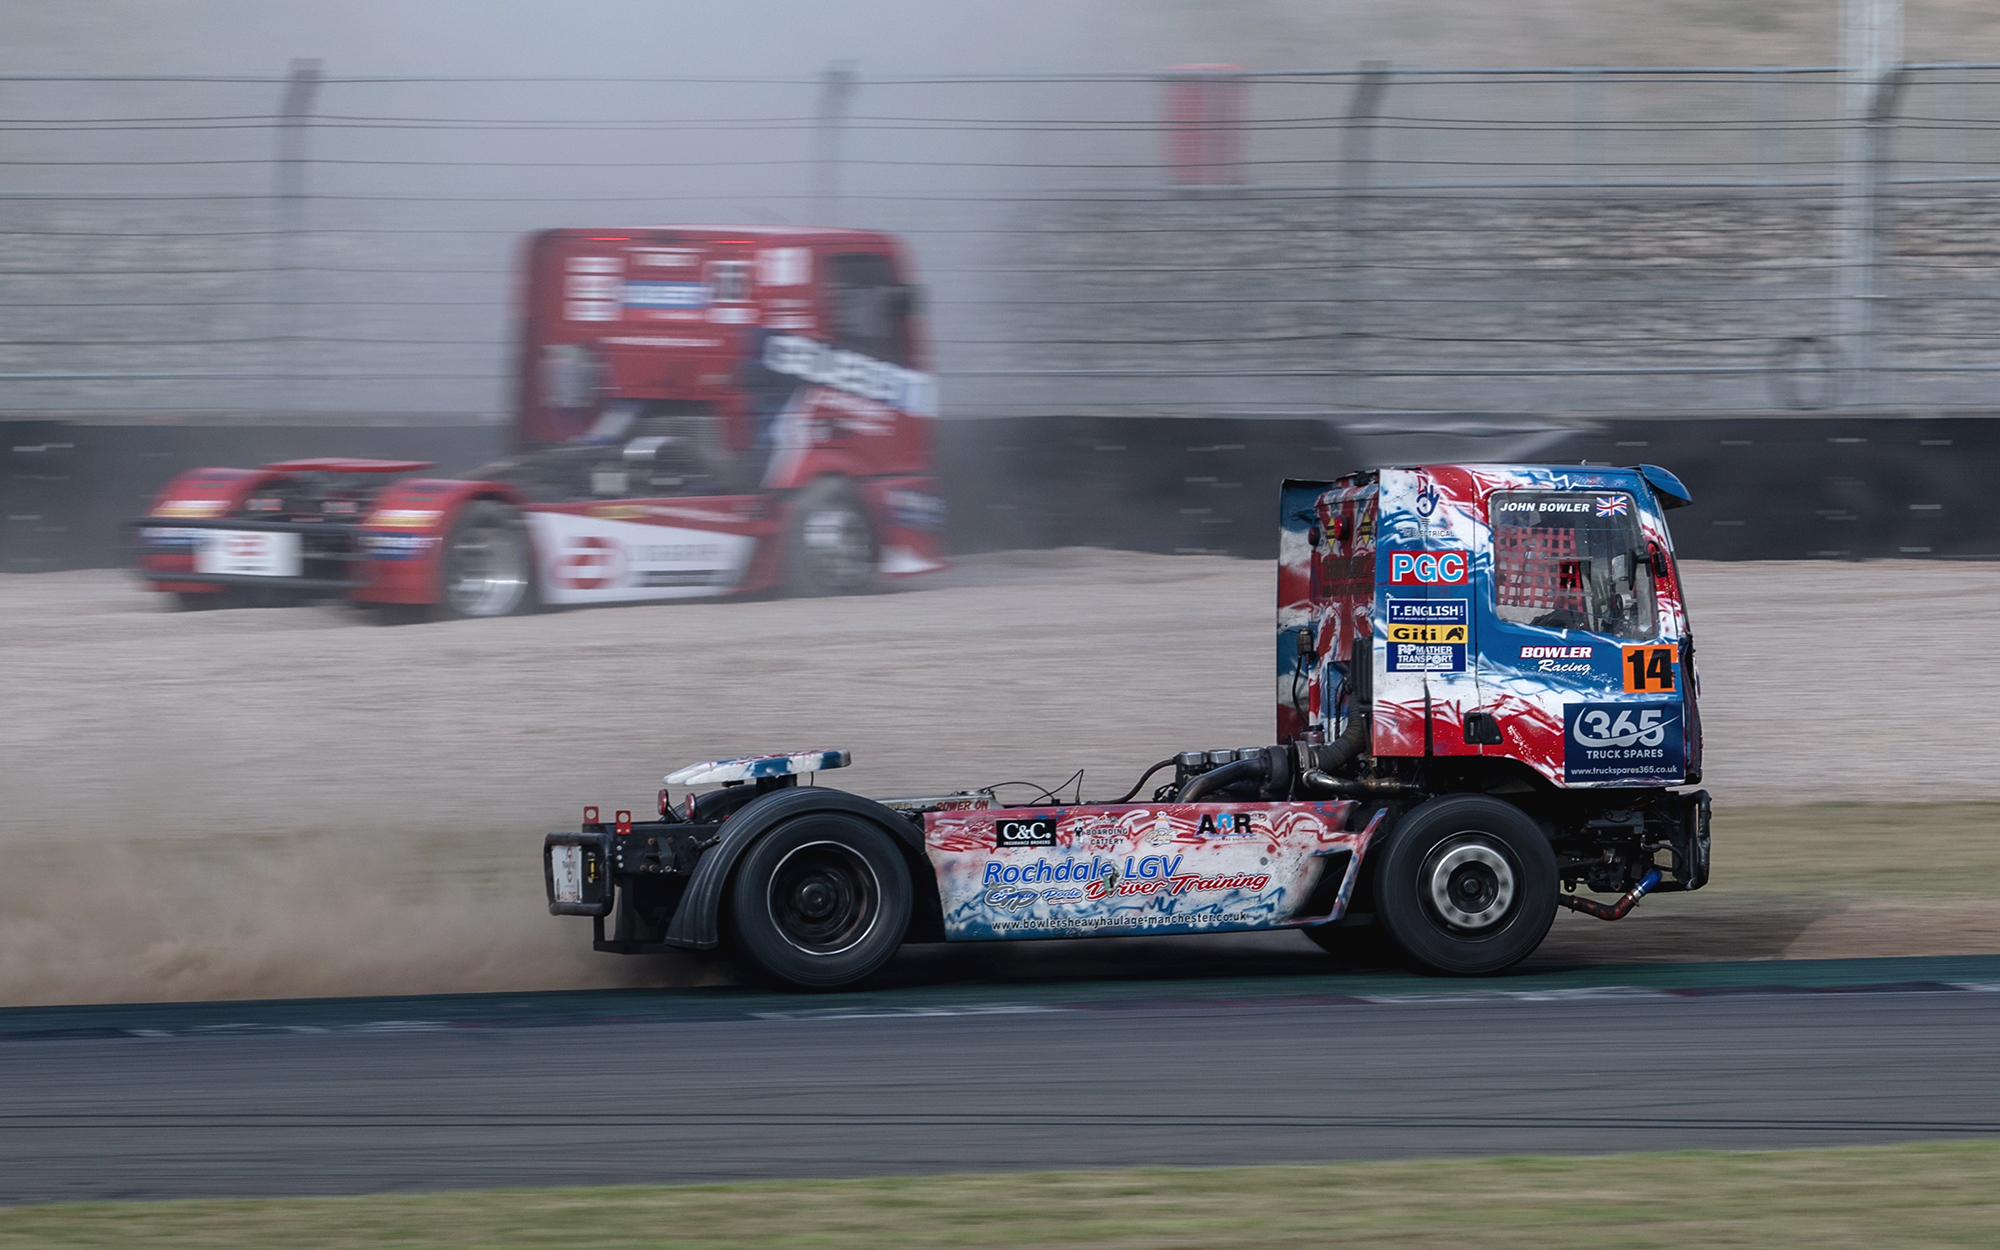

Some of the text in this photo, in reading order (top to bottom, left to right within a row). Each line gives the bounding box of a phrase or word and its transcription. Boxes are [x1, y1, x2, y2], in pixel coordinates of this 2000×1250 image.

[1500, 502, 1591, 512] JOHN BOWLER
[1392, 553, 1465, 583] PGC
[1391, 605, 1459, 617] T.ENGLISH
[1392, 628, 1437, 641] Giti
[1416, 646, 1453, 655] MATHER
[1520, 646, 1592, 659] BOWLER
[1537, 658, 1592, 676] Racing
[1627, 649, 1675, 690] 14
[1583, 709, 1665, 747] 365
[1586, 749, 1664, 760] TRUCK SPARES
[1570, 765, 1678, 777] www.truckspares365.co.uk
[974, 799, 990, 811] ON
[1086, 828, 1128, 836] BOARDING
[1090, 838, 1124, 846] CATTERY
[983, 854, 1183, 885] Rochdale LGV
[1170, 872, 1270, 896] Training
